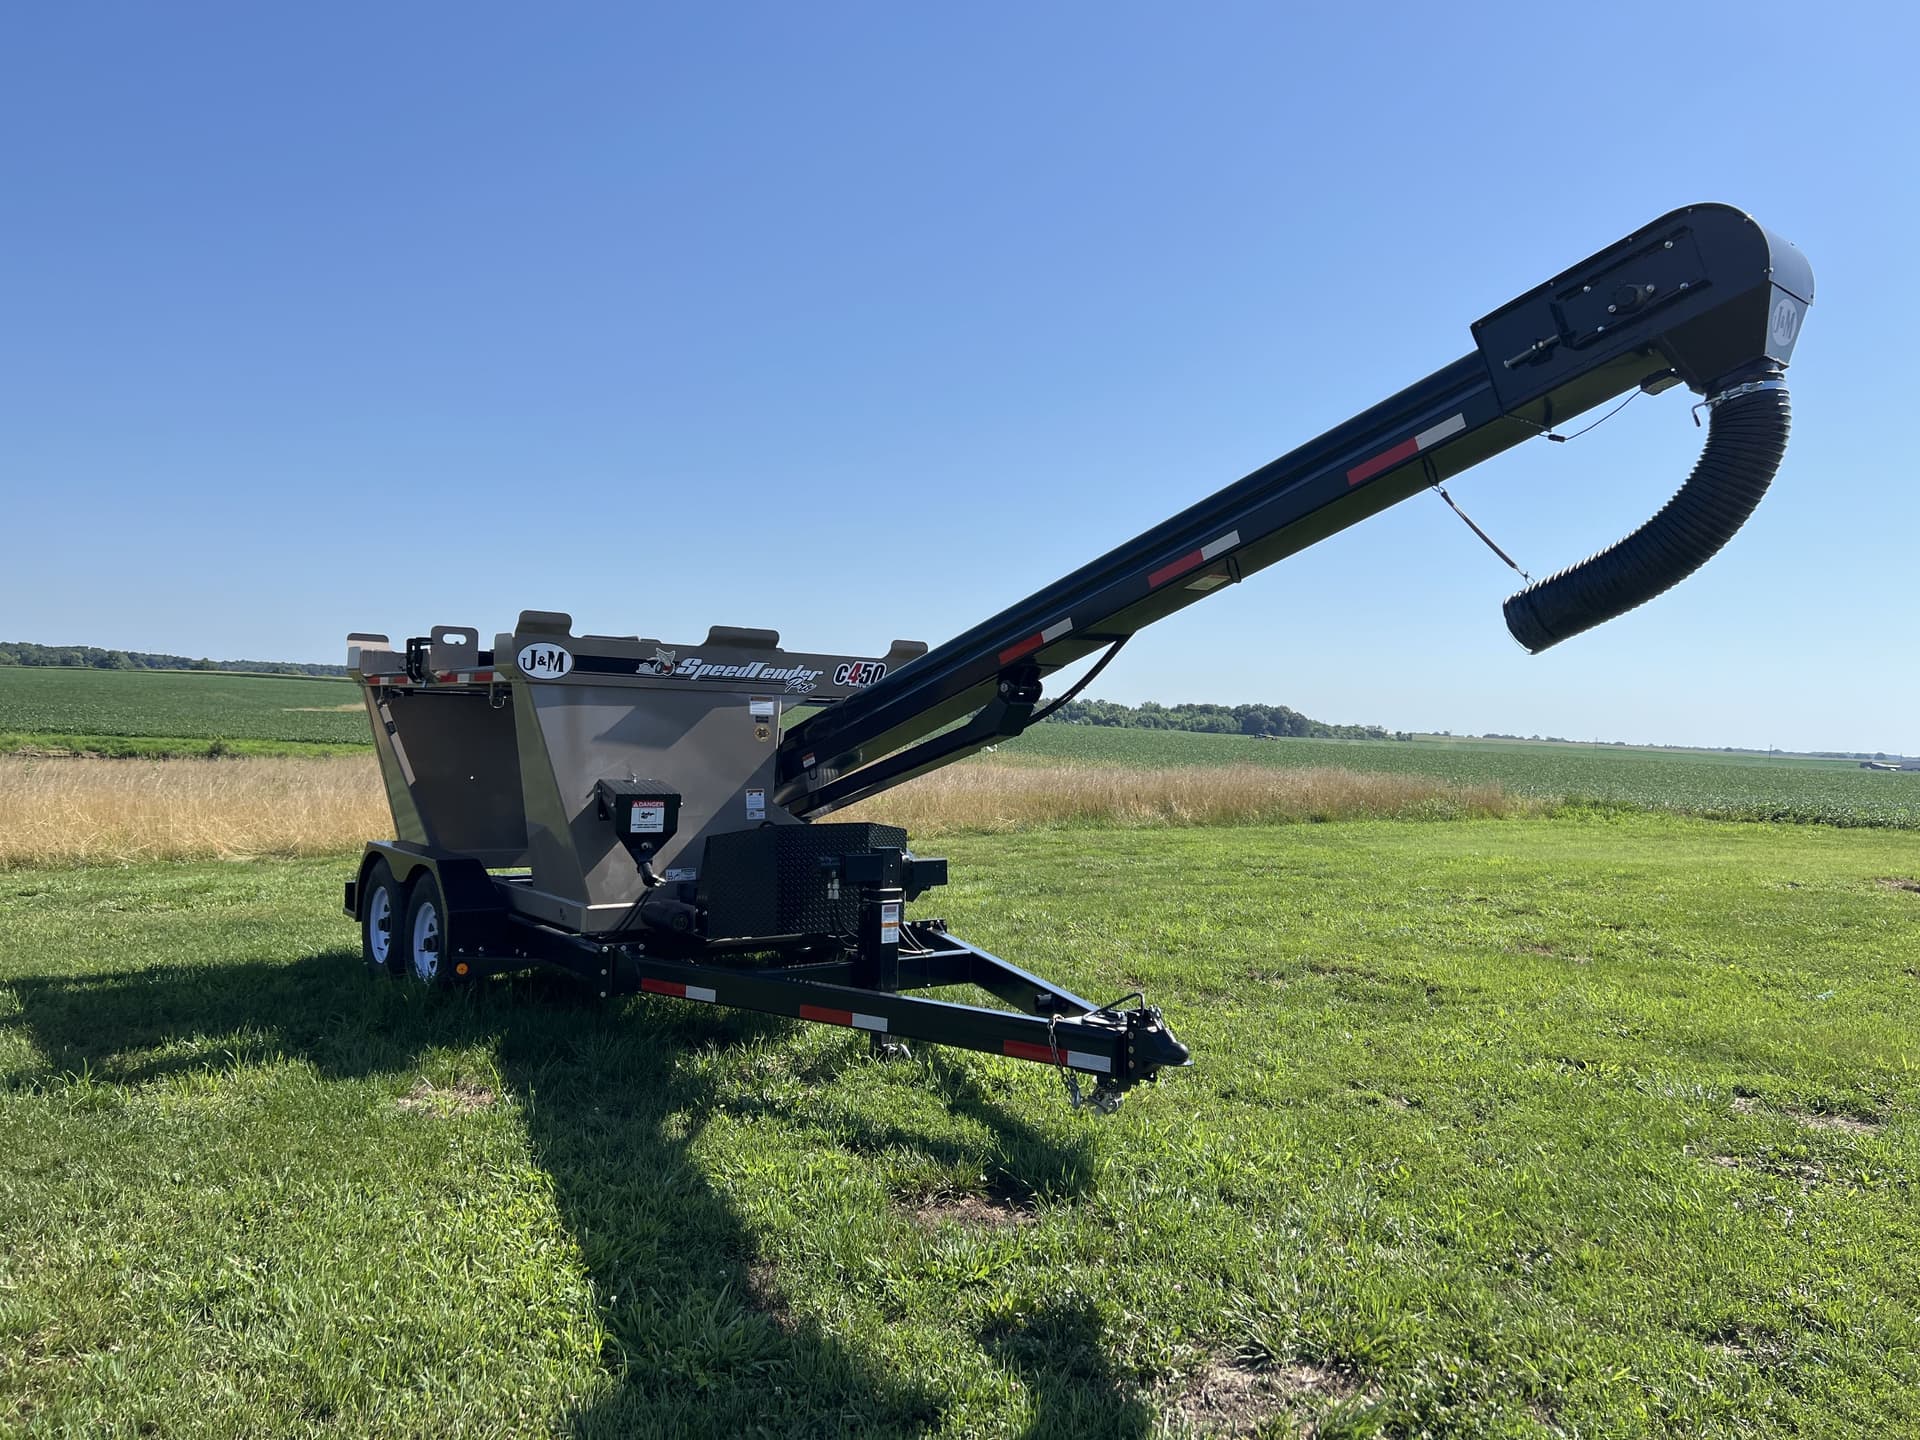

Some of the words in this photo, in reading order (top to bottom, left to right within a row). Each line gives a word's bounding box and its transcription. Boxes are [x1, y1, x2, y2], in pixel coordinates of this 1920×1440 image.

[521, 649, 565, 673] J&M
[676, 657, 824, 681] SpeedTender
[784, 676, 817, 694] Pro
